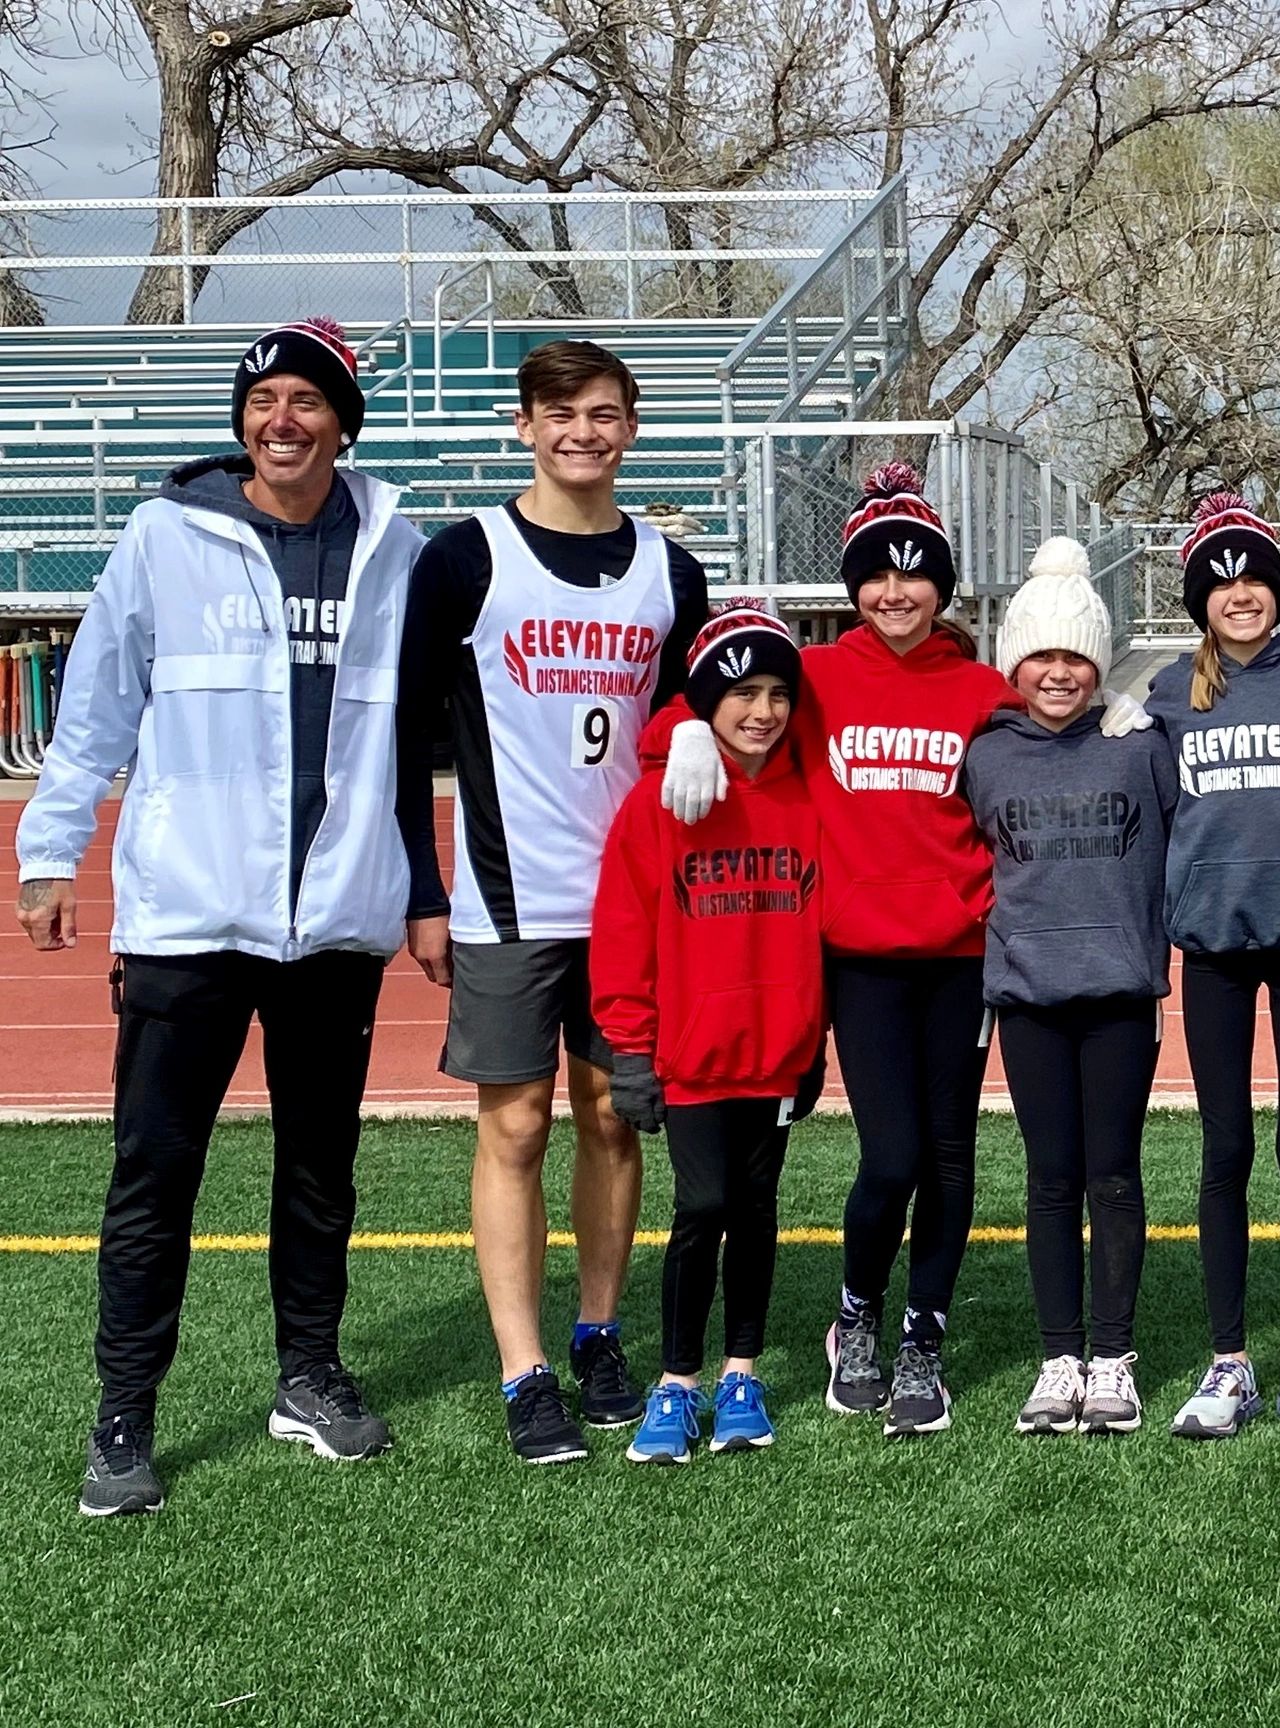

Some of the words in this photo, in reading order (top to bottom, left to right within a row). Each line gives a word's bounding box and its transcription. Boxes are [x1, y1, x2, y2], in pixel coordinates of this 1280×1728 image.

[521, 619, 656, 664] ELEVATED
[537, 668, 594, 694] DISTANCE
[594, 670, 636, 696] TRAININ
[583, 707, 610, 765] 9
[841, 725, 964, 766] ELEVATED
[851, 767, 900, 790] DISTANCE
[1197, 766, 1243, 794] DISTANCE
[1069, 834, 1119, 858] TRAINING
[684, 847, 803, 886] ELEVATED
